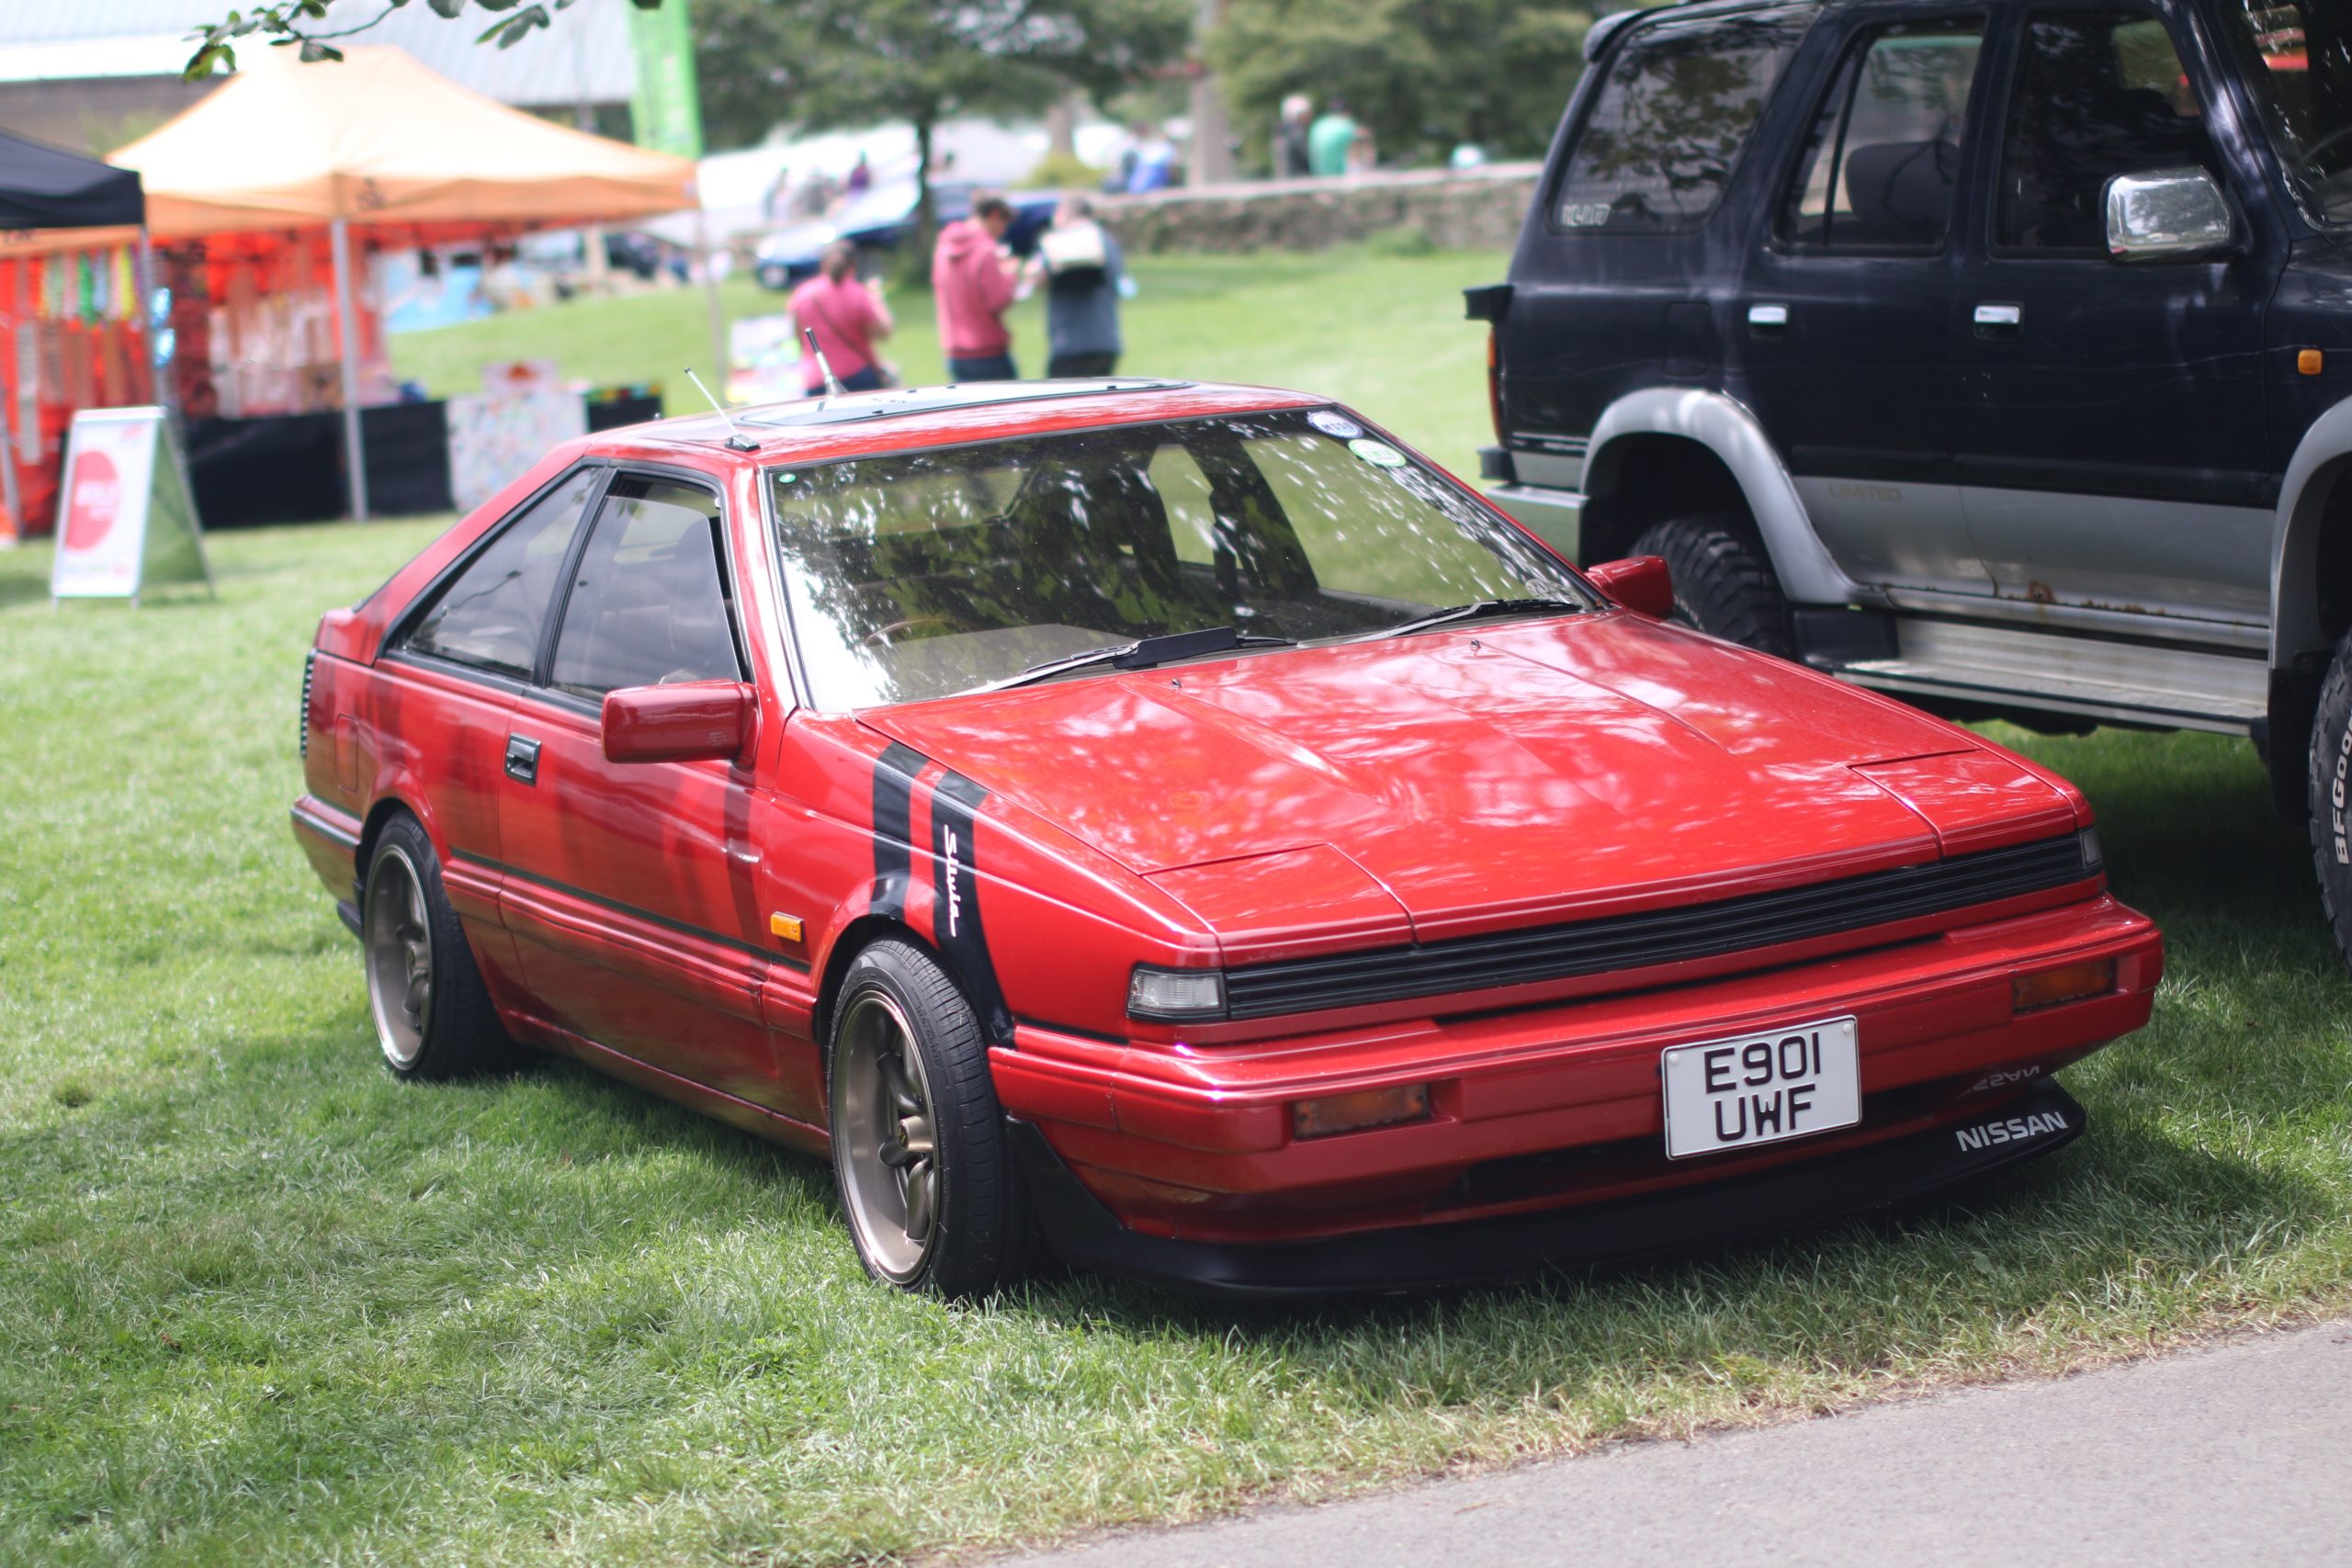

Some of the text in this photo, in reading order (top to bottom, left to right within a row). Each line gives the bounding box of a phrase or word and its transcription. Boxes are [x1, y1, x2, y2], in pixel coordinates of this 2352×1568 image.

[1826, 483, 1902, 502] LIMITED
[944, 823, 962, 938] Silvia
[1703, 1031, 1821, 1094] E901
[1713, 1082, 1816, 1142] UWF
[1955, 1111, 2069, 1152] NISSAN
